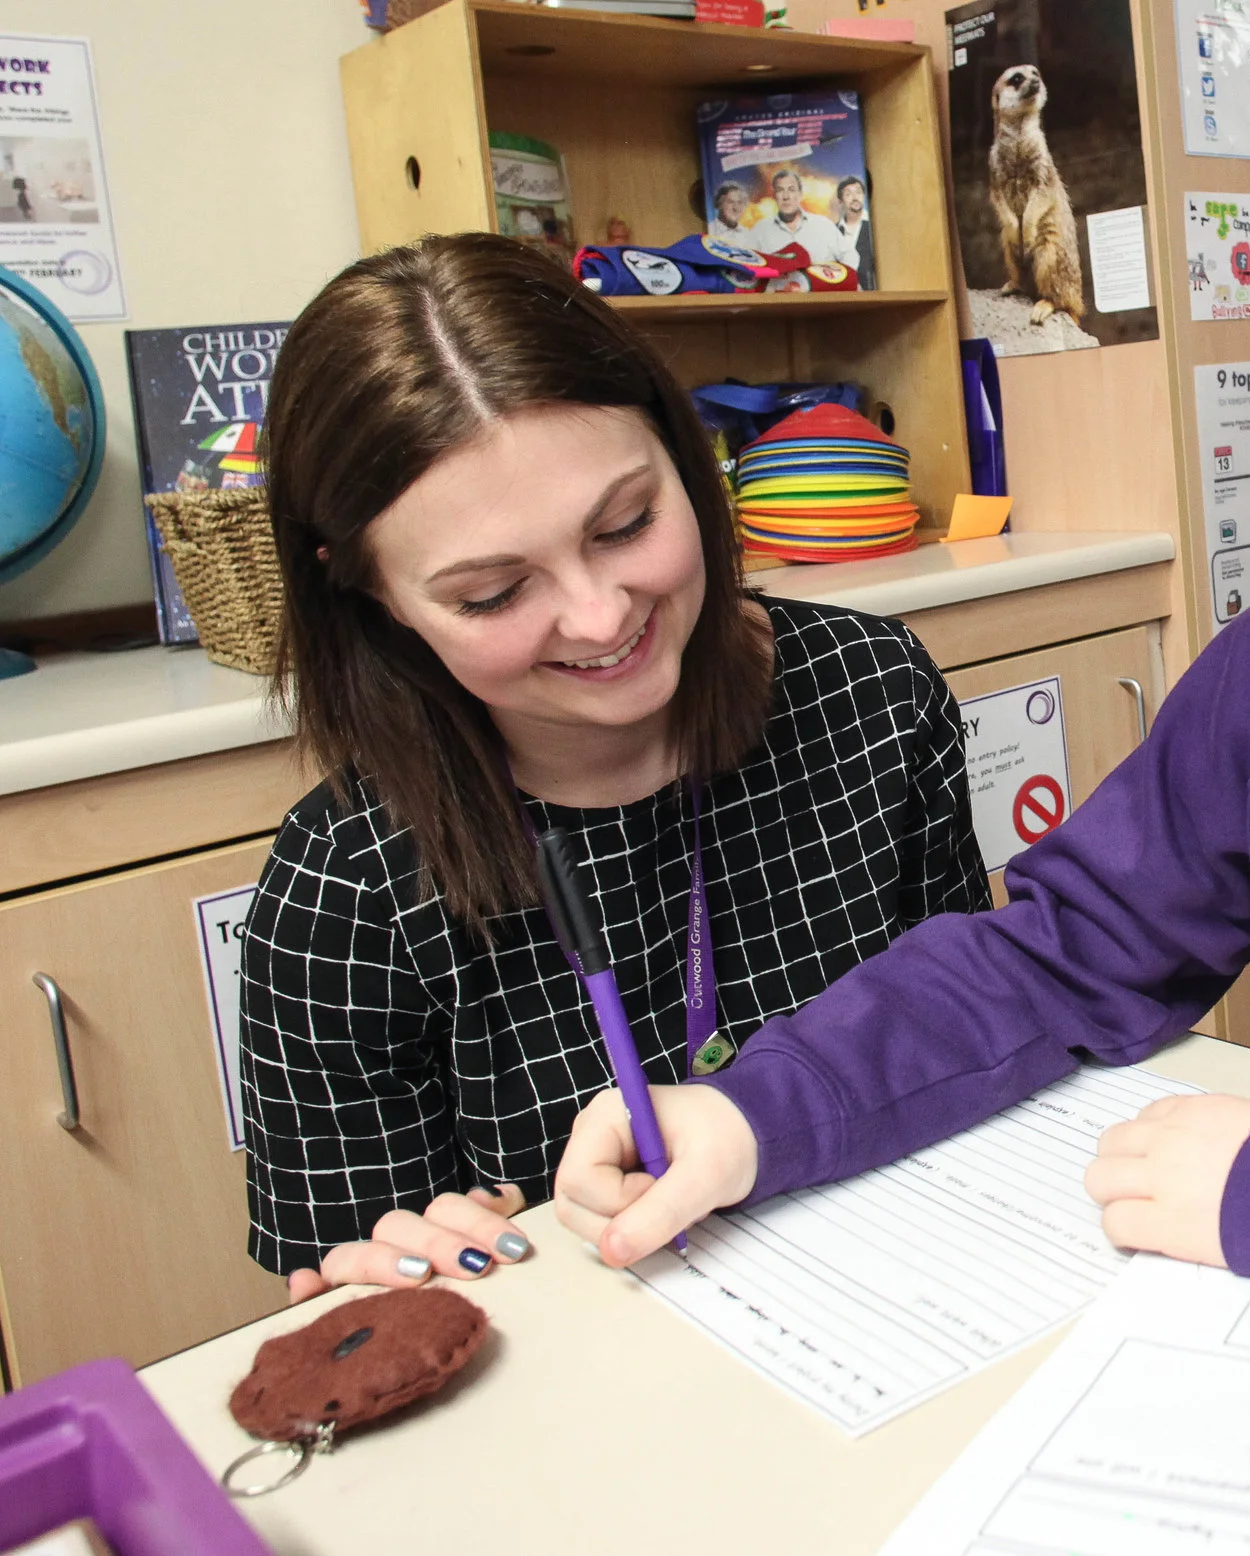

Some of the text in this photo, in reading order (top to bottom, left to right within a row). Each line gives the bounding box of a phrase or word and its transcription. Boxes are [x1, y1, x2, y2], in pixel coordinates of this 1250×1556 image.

[1217, 369, 1227, 389] 9
[1218, 456, 1230, 471] 13
[690, 856, 704, 1010] Outwood Grange Famil
